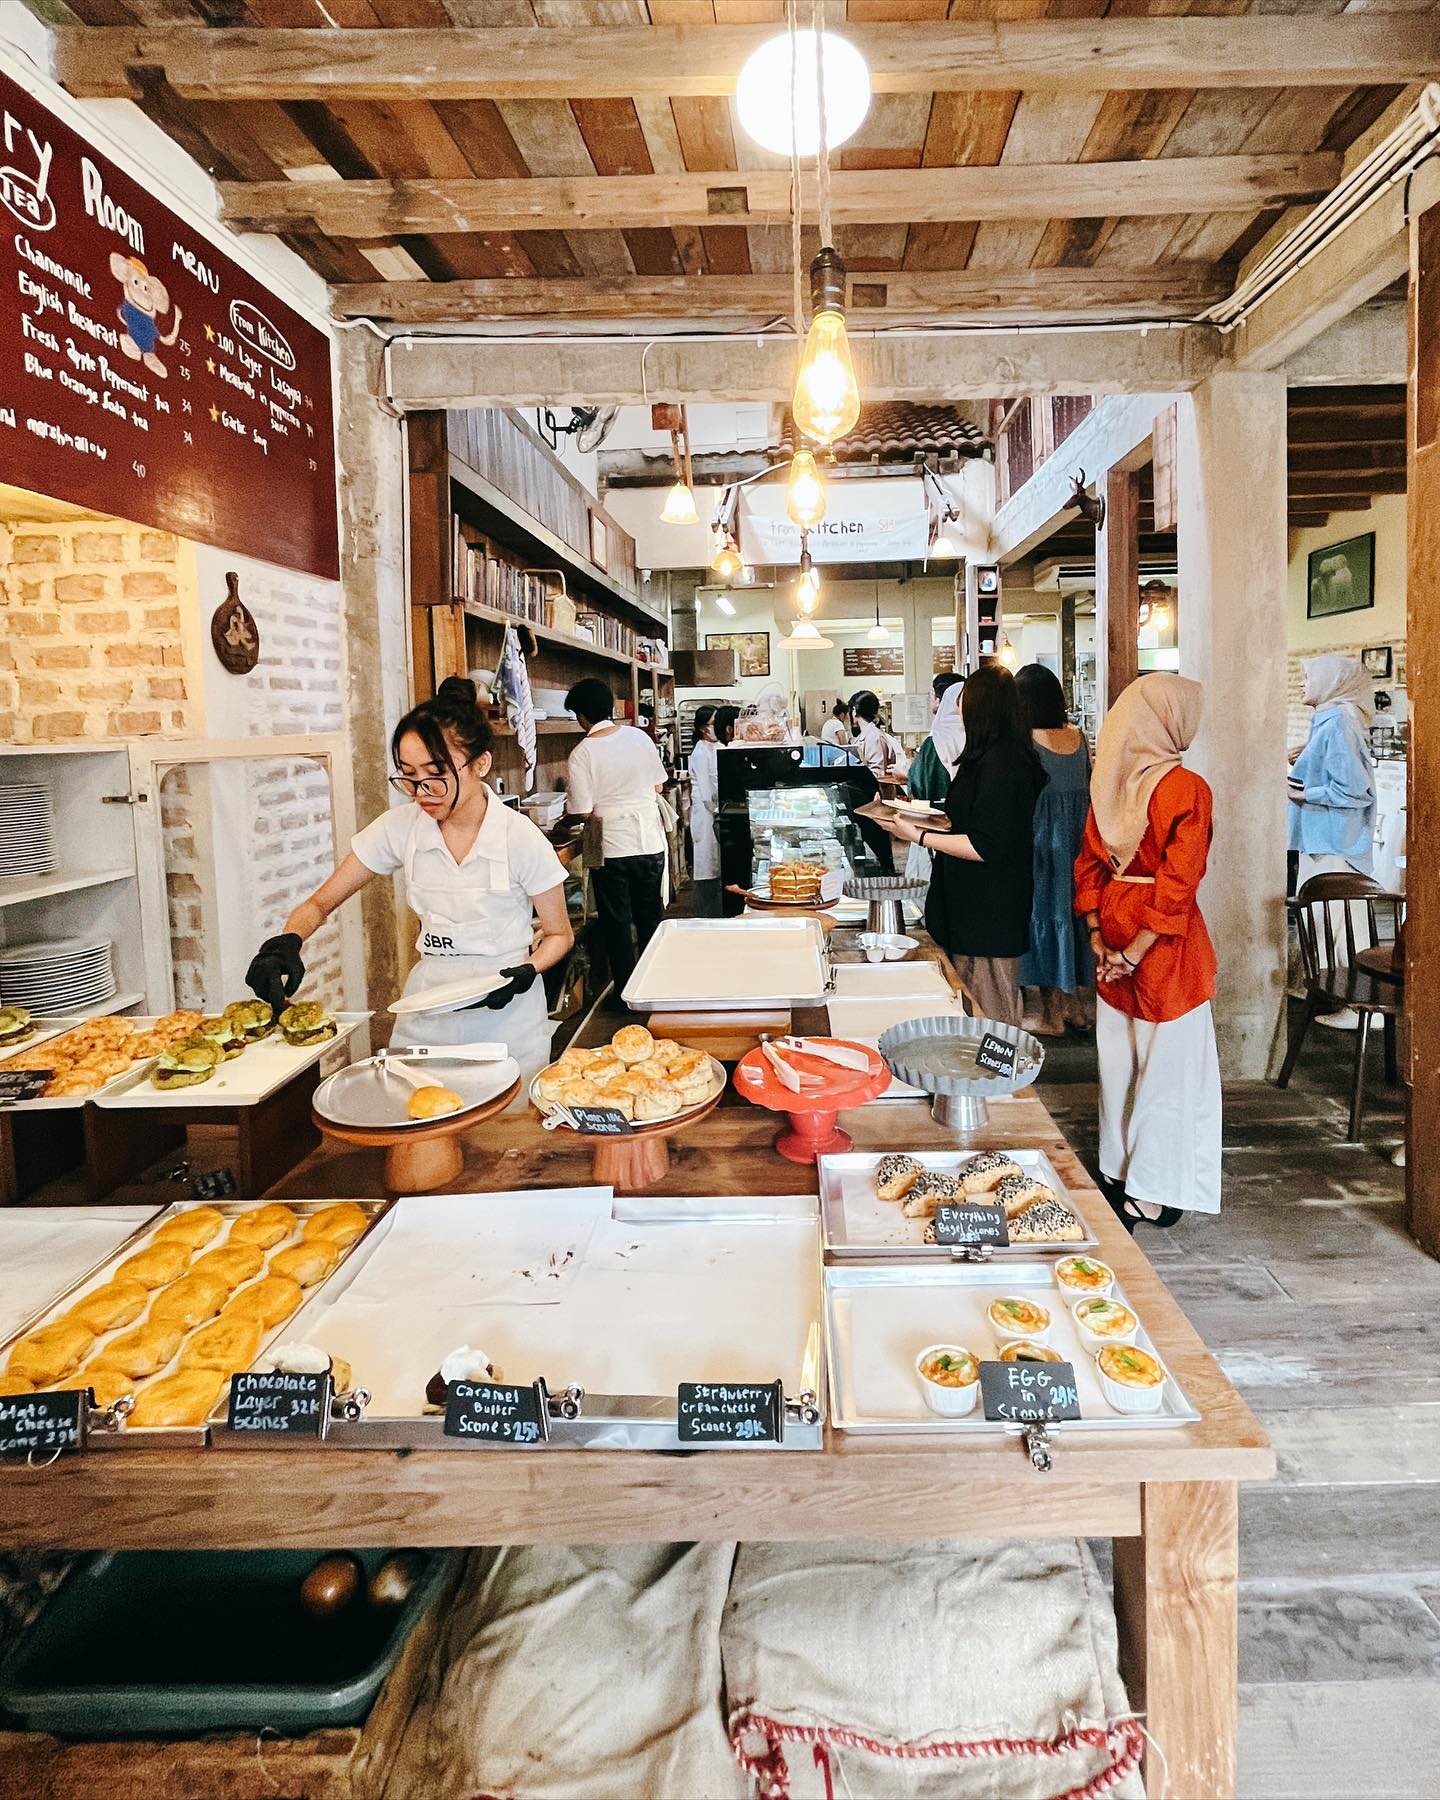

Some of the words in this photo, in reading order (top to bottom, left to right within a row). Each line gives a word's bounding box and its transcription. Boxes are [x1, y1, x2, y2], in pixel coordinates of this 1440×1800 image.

[81, 157, 145, 255] Room
[15, 234, 93, 300] Chamomile
[18, 270, 64, 316] English
[21, 312, 60, 353] Fresh
[232, 307, 254, 335] From
[258, 321, 292, 366] Kitchen
[217, 332, 235, 356] 100
[24, 352, 53, 381] Blue
[59, 369, 99, 404] Orange
[101, 391, 127, 420] Soda
[26, 418, 107, 460] marshmallow
[132, 460, 146, 478] 40
[424, 933, 455, 949] SBR
[984, 1038, 1013, 1058] LEMON
[941, 1208, 1000, 1224] Everything
[938, 1222, 964, 1238] Bagel
[1008, 1367, 1053, 1389] EGG
[456, 1385, 519, 1403] Caramel
[695, 1385, 772, 1406] Strawberry
[235, 1395, 282, 1415] Layer
[474, 1402, 517, 1416] Butter
[459, 1415, 511, 1436] Scones
[691, 1418, 732, 1435] Scones
